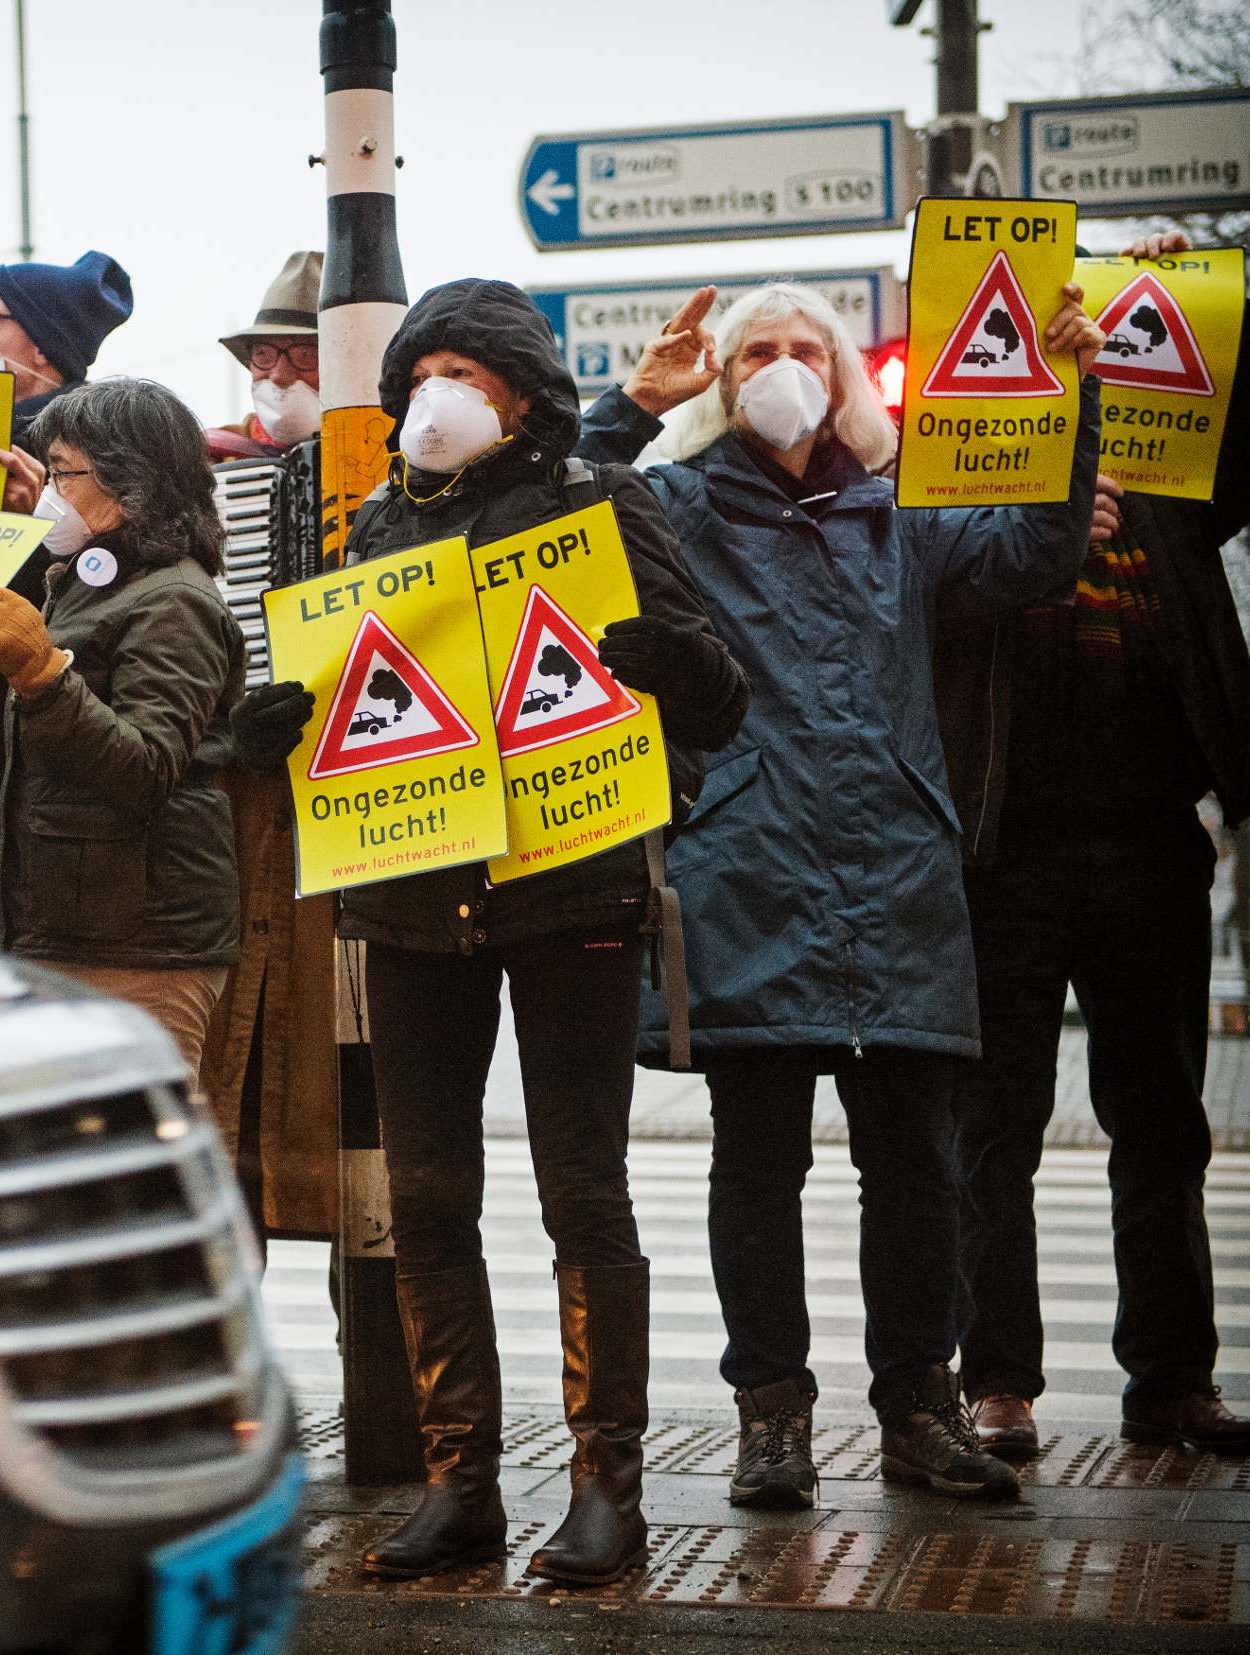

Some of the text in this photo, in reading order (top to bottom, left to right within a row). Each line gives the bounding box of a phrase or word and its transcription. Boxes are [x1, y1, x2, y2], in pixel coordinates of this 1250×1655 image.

[1039, 157, 1240, 192] Centrumring
[587, 179, 874, 223] Centrumring S 100
[944, 215, 1057, 243] LET OP!
[1158, 258, 1210, 273] OP!
[918, 411, 1066, 444] Ongezonde
[1101, 403, 1210, 433] ezonde
[954, 447, 1030, 472] lucht!
[1099, 436, 1166, 461] ucht!
[926, 480, 1046, 496] www.luchtwacht.nl
[537, 528, 591, 569] OP!
[300, 560, 436, 622] LET OP!
[504, 734, 651, 800] ngezonde
[311, 766, 487, 820] Ongezonde
[540, 779, 621, 830] lucht!
[358, 807, 447, 848] lucht!
[519, 809, 646, 865] www.luchtwacht.nl
[331, 837, 476, 878] www.luchtwacht.nl
